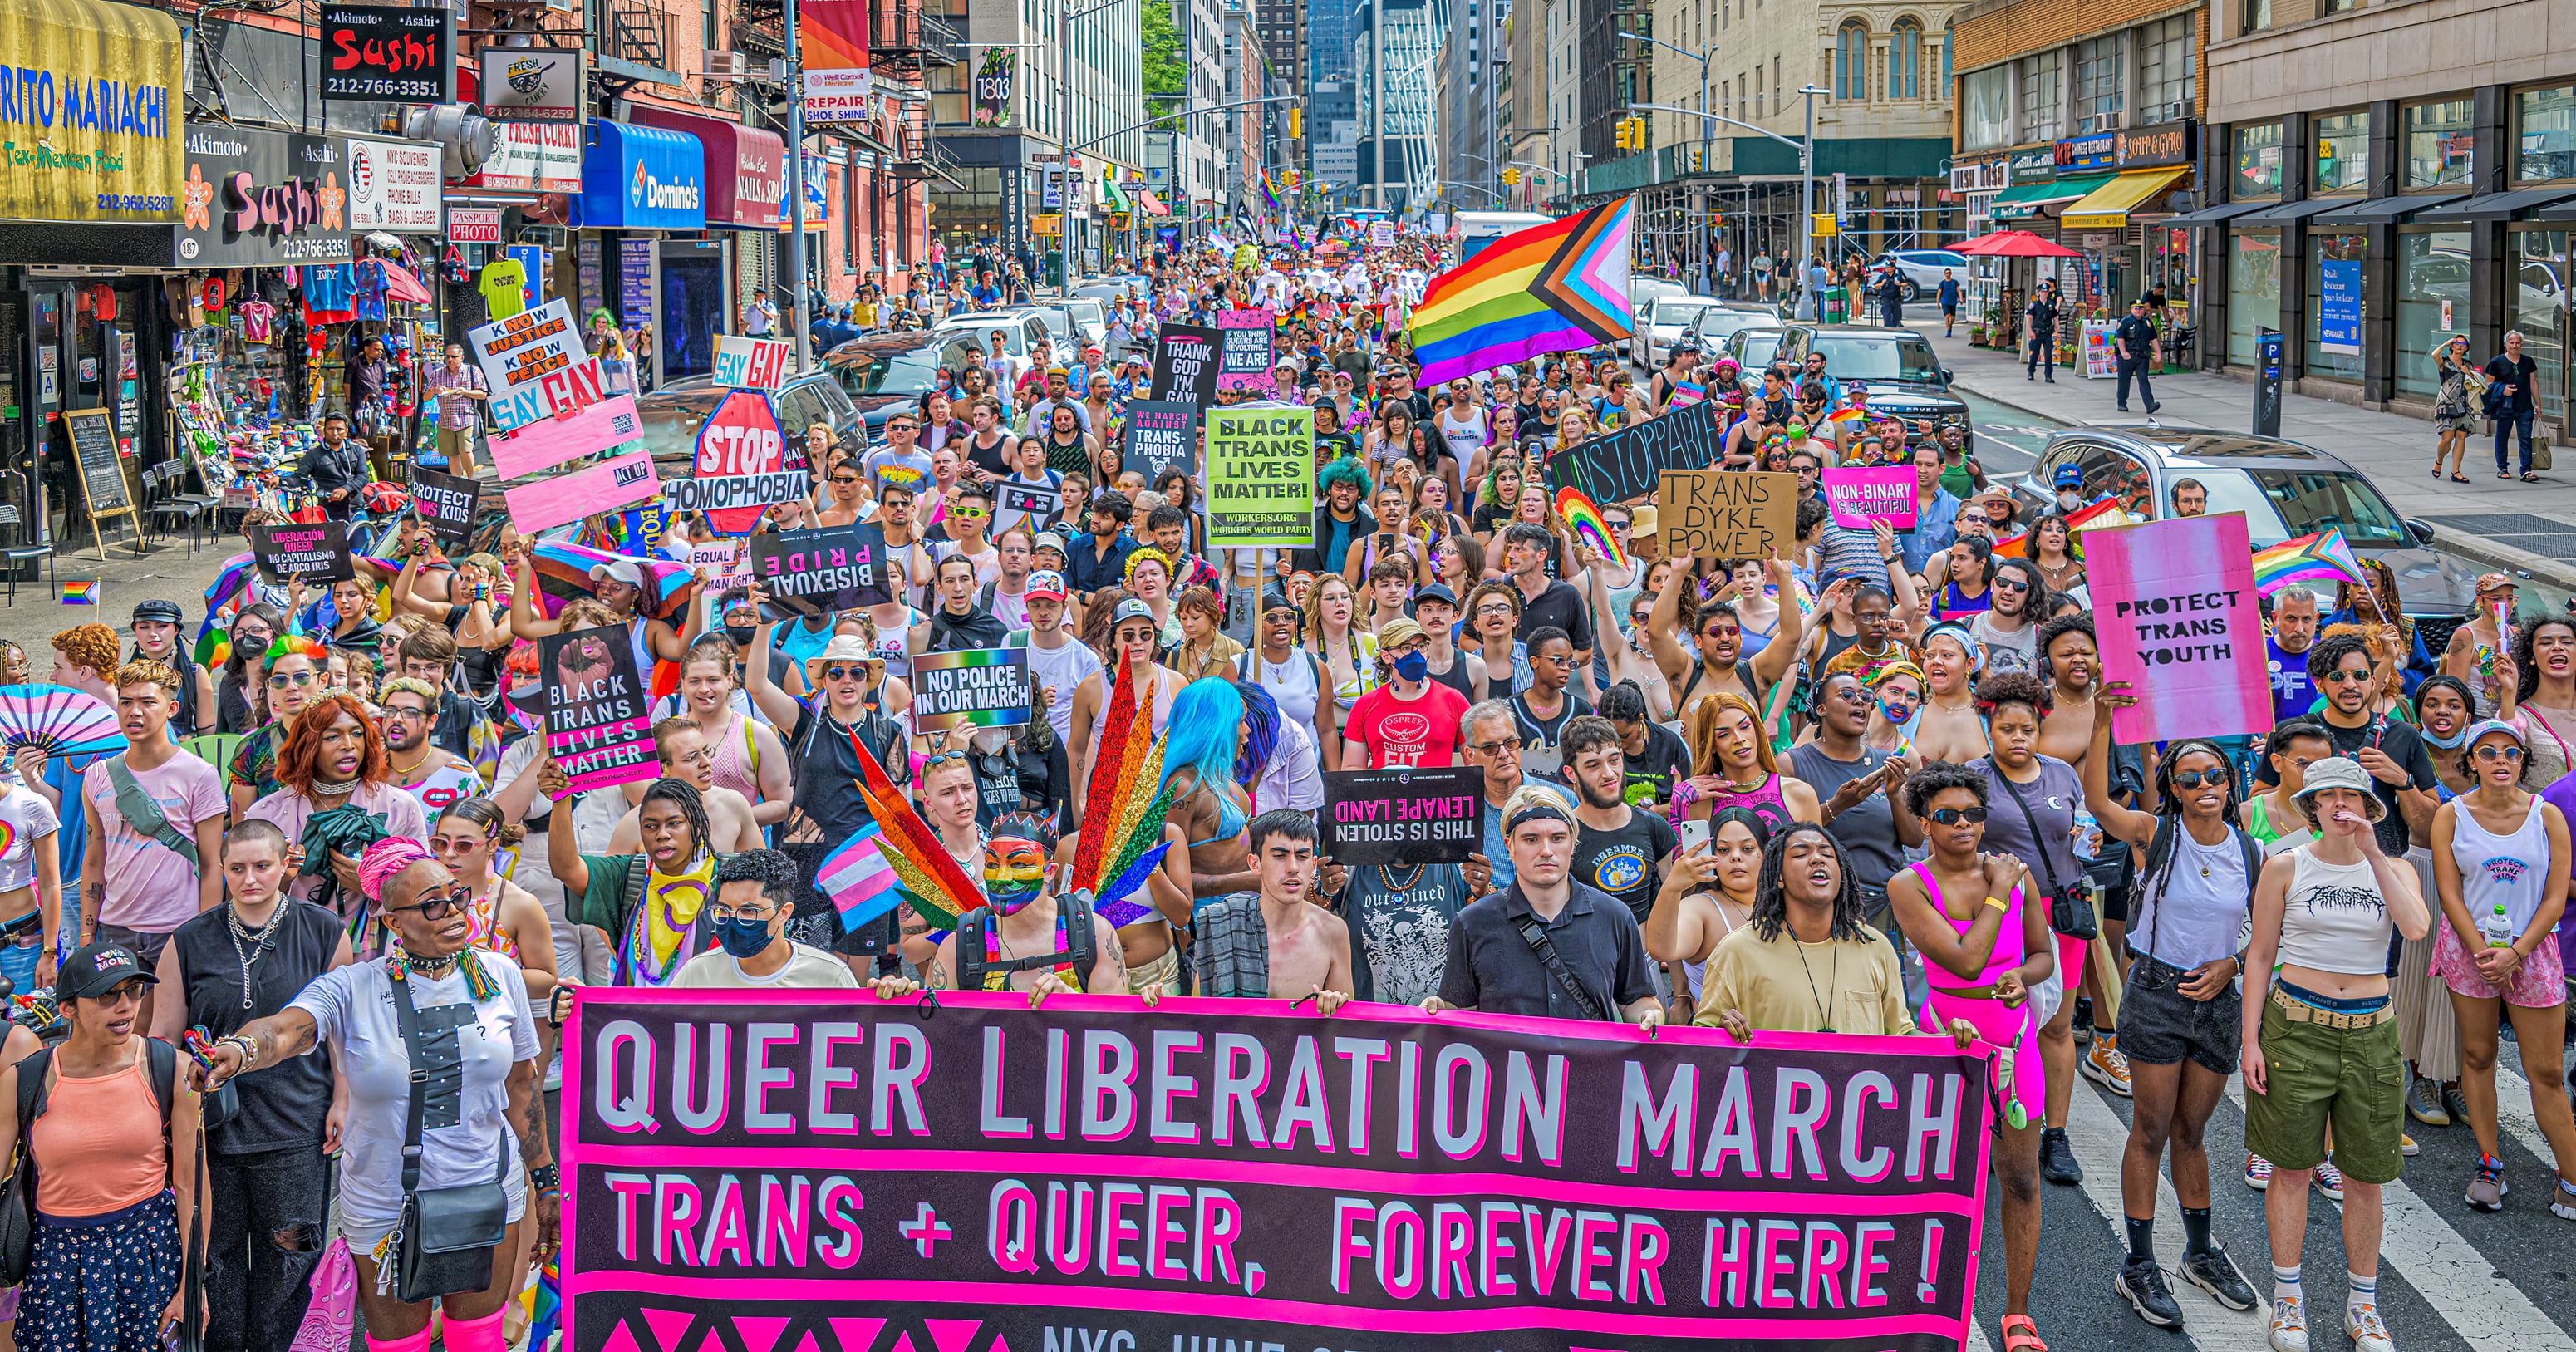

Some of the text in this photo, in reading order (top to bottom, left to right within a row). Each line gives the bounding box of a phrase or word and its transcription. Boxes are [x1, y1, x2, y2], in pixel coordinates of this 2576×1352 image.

[333, 12, 435, 27] Akimoto Asahi
[332, 29, 435, 73] Sushi
[507, 58, 539, 73] FRESH
[327, 78, 439, 97] 212-766-3351
[525, 82, 550, 106] CURRY
[977, 77, 1010, 100] 1803
[62, 71, 166, 139] MARIACHI
[807, 96, 864, 108] REPAIR
[807, 110, 866, 120] SHOE SHINE
[543, 124, 576, 149] CURRY
[2128, 135, 2151, 159] SOUP
[2159, 131, 2183, 159] GYRO
[3, 140, 123, 173] Tex-Mexican Food
[190, 133, 334, 163] Akimoto Asahi
[387, 149, 428, 167] NYC SOUVENIRS
[387, 189, 420, 204] PHONE BILLS
[647, 175, 699, 210] Domino's
[737, 175, 761, 203] NAILS
[766, 180, 780, 204] SPA
[1007, 169, 1017, 223] HUNGRY
[97, 194, 174, 210] 212-962-5287
[233, 170, 321, 236] Sushi
[388, 209, 403, 224] BAGS
[409, 210, 435, 224] LUGGAGES
[453, 213, 497, 224] PASSPORT
[453, 225, 497, 240] PHOTO
[182, 242, 196, 255] 187
[283, 238, 349, 258] 212-766-3351
[317, 269, 339, 280] NY
[491, 307, 548, 337] KNOW
[486, 317, 567, 356] JUSTICE
[504, 340, 562, 370] KNOW
[1167, 342, 1213, 361] THANK
[1226, 352, 1268, 366] WE ARE
[2269, 345, 2277, 356] P
[507, 352, 569, 386] PEACE
[715, 341, 789, 388] SAY GAY
[1172, 359, 1201, 376] GOD
[44, 376, 53, 393] A
[1173, 375, 1194, 391] I'M
[492, 359, 605, 430] SAY GAY
[1136, 419, 1187, 430] AGAINST
[1155, 411, 1187, 420] MARCH
[1135, 430, 1186, 443] TRANS-
[1220, 418, 1305, 436] BLACK
[700, 425, 779, 474] STOP
[1134, 443, 1186, 457] PHOBIA
[1214, 440, 1309, 457] TRANS
[1553, 400, 1721, 506] UNSTOPPABLE
[616, 462, 646, 484] ACT UP
[1226, 461, 1300, 479] LIVES
[413, 481, 472, 508] PROTECT
[666, 474, 805, 512] HOMOPHOBIA
[1214, 483, 1308, 499] MATTER!
[1661, 474, 1769, 505] TRANS
[1832, 483, 1910, 500] NON-BINARY
[440, 505, 469, 524] KIDS
[1836, 500, 1910, 514] IS BEAUTIFUL
[1226, 513, 1297, 523] WORKERS.ORG
[1685, 506, 1765, 529] DYKE
[271, 528, 325, 543] LIBERACIÓN
[1212, 525, 1311, 534] WORKERS WORLD PARTY
[284, 542, 314, 552] QUEER
[1669, 528, 1774, 555] POWER
[268, 551, 336, 564] NO CAPITALISMO
[694, 550, 730, 563] EQUAL
[764, 544, 871, 575] PRIDE
[277, 561, 330, 573] DE ARCO IRIS
[767, 563, 873, 597] BISEXUAL
[2116, 590, 2239, 618] PROTECT
[2135, 618, 2226, 641] TRANS
[2137, 643, 2231, 666] YOUTH
[927, 666, 1016, 693] NO POLICE
[551, 675, 628, 706] BLACK
[917, 686, 1029, 715] IN OUR MARCH
[551, 699, 632, 731] TRANS
[1385, 716, 1424, 725] OSPREY
[553, 722, 637, 756] LIVES
[1383, 742, 1426, 752] CUSTOM
[561, 745, 643, 775] MATTER
[1384, 750, 1424, 768] FIT
[984, 789, 1000, 804] GOES
[1335, 799, 1390, 822] LAND
[1397, 796, 1474, 820] LENAPE
[1335, 820, 1475, 842] THIS IS STOLEN
[1591, 844, 1645, 868] DREAMER
[2485, 858, 2524, 871] PROTECT
[2490, 866, 2520, 876] TRANS
[2495, 873, 2515, 882] KIDS
[95, 957, 132, 971] MORE
[1556, 972, 1594, 1014] ADIDAS
[2308, 995, 2337, 1007] HANES
[595, 1018, 1964, 1182] QUEER LIBERATION MARCH
[604, 1172, 1944, 1310] TRANS + QUEER, FOREVER HERE !
